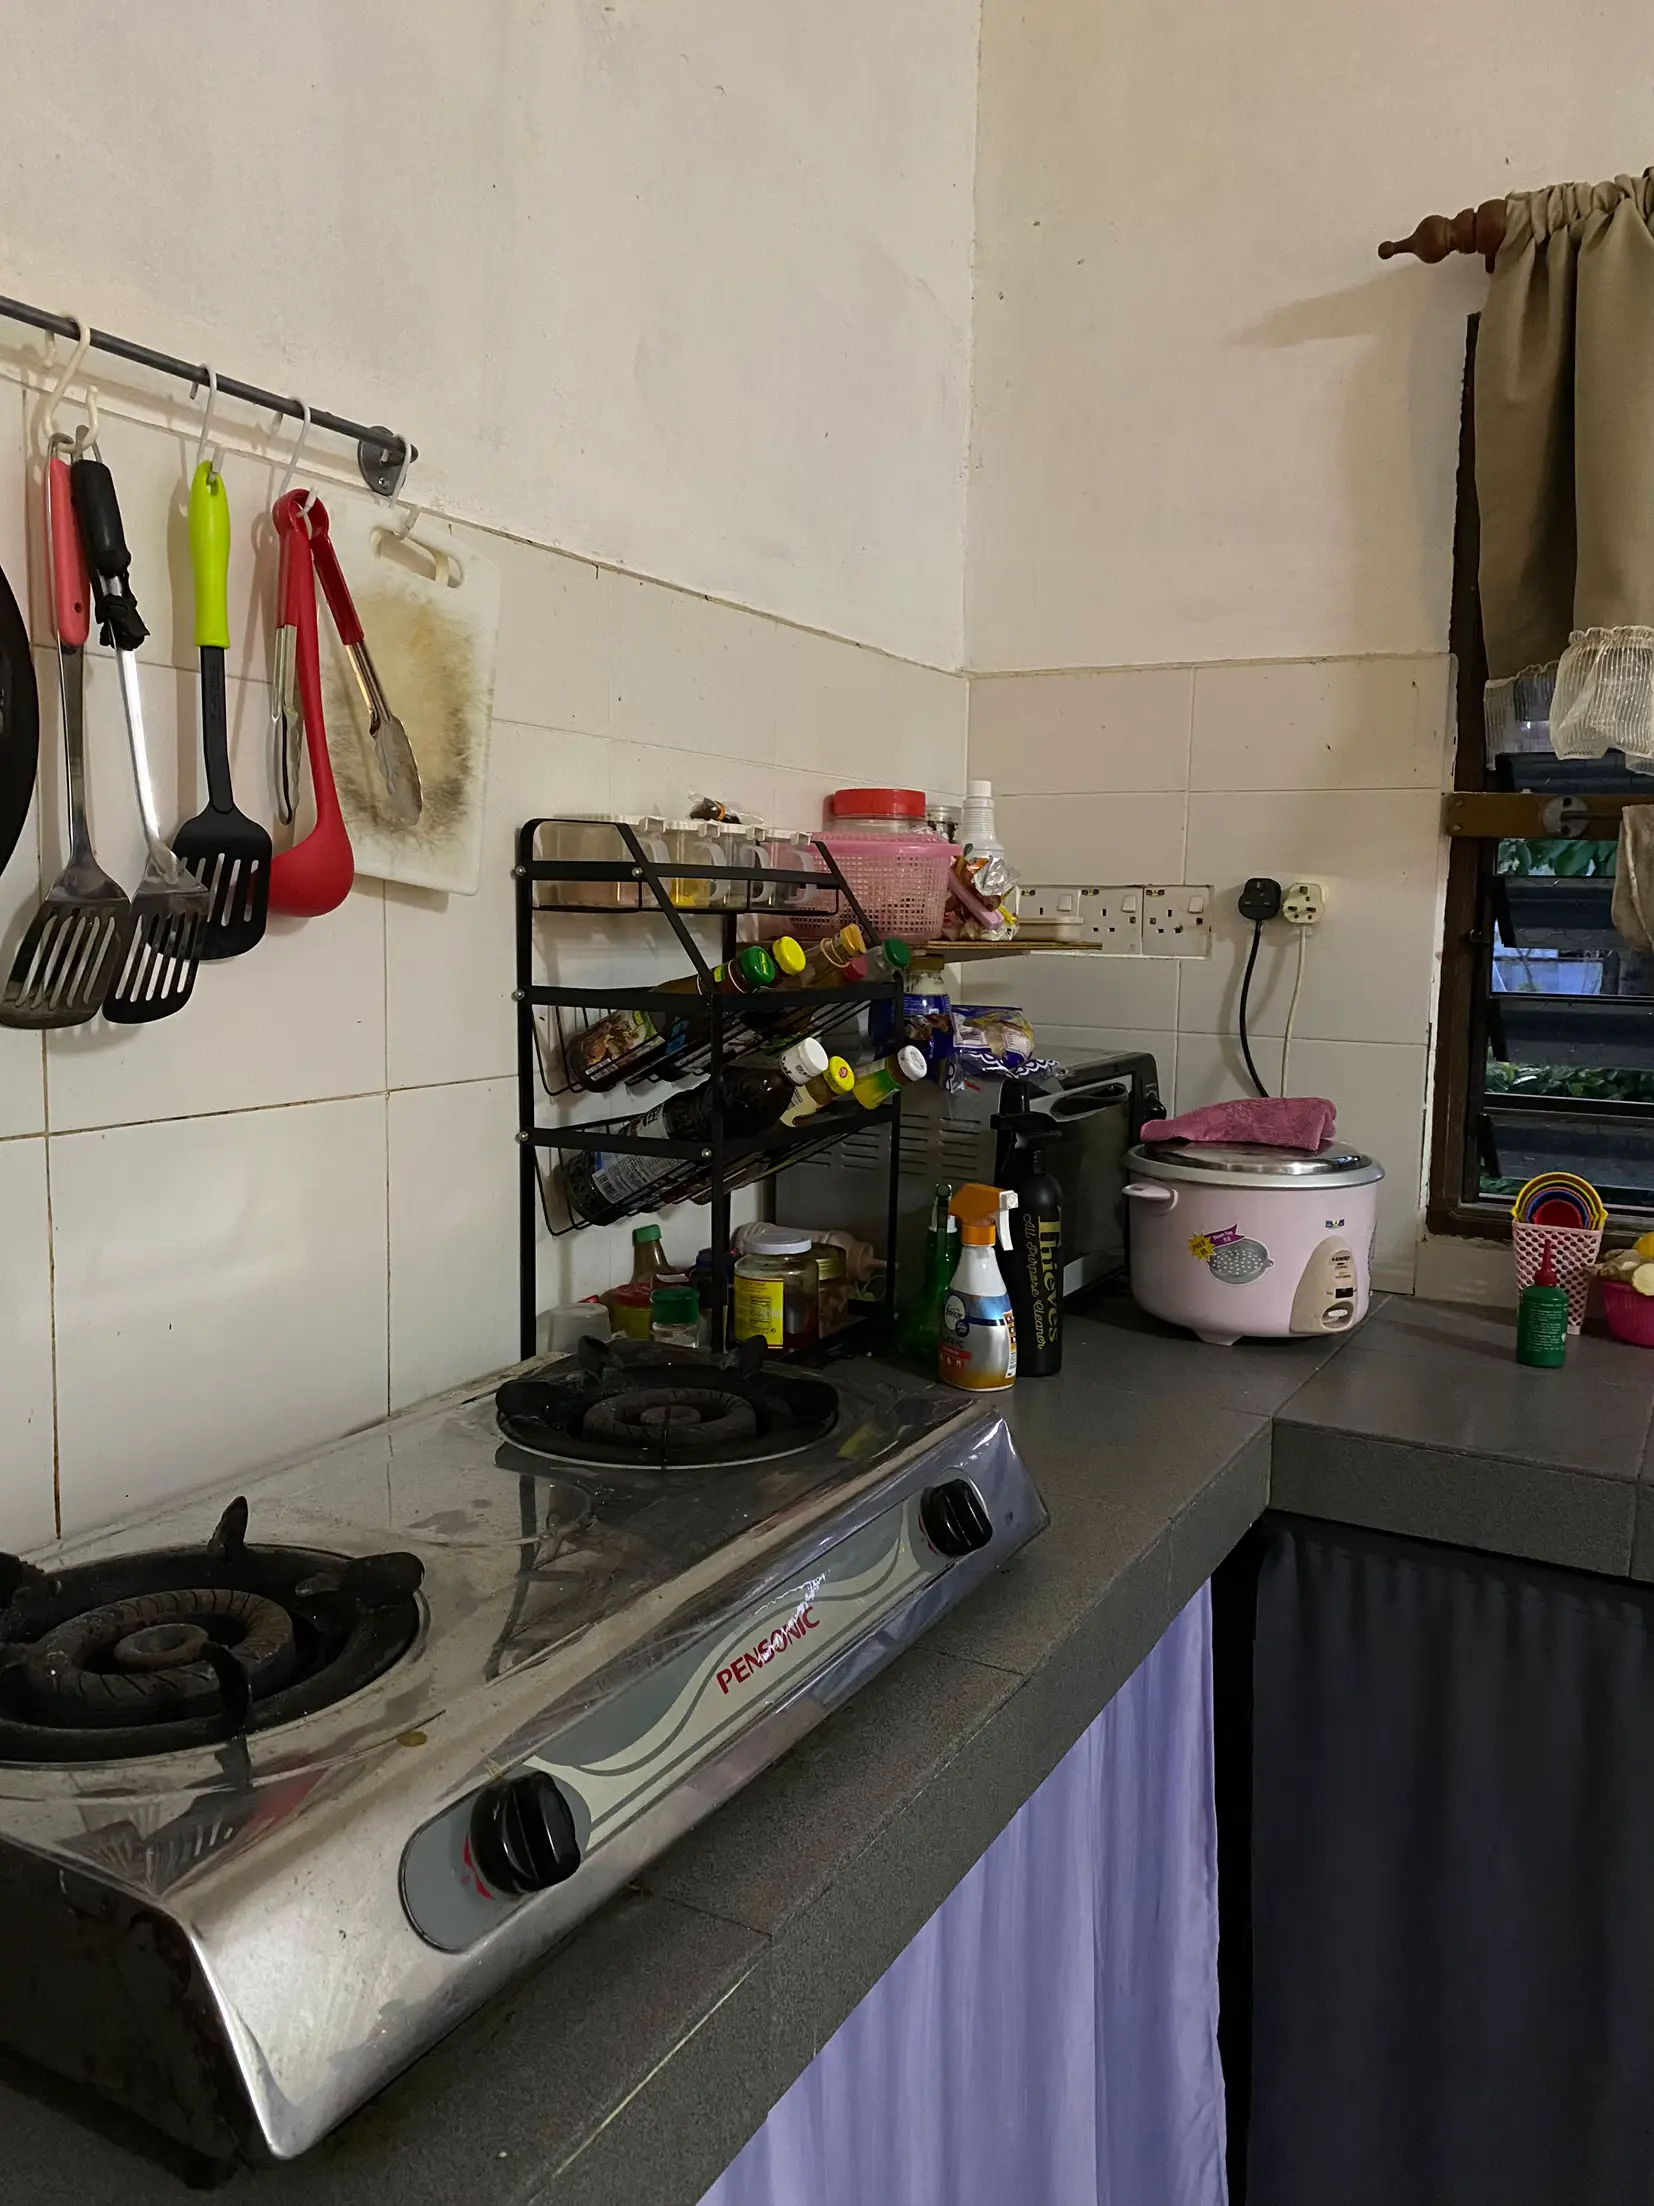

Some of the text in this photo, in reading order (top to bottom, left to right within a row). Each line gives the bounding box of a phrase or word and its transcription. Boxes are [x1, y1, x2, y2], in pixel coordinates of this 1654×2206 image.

[1022, 1213, 1046, 1348] All Purpose Cleaner
[1037, 1204, 1061, 1342] Thieves
[716, 1606, 820, 1695] PENSONIC
